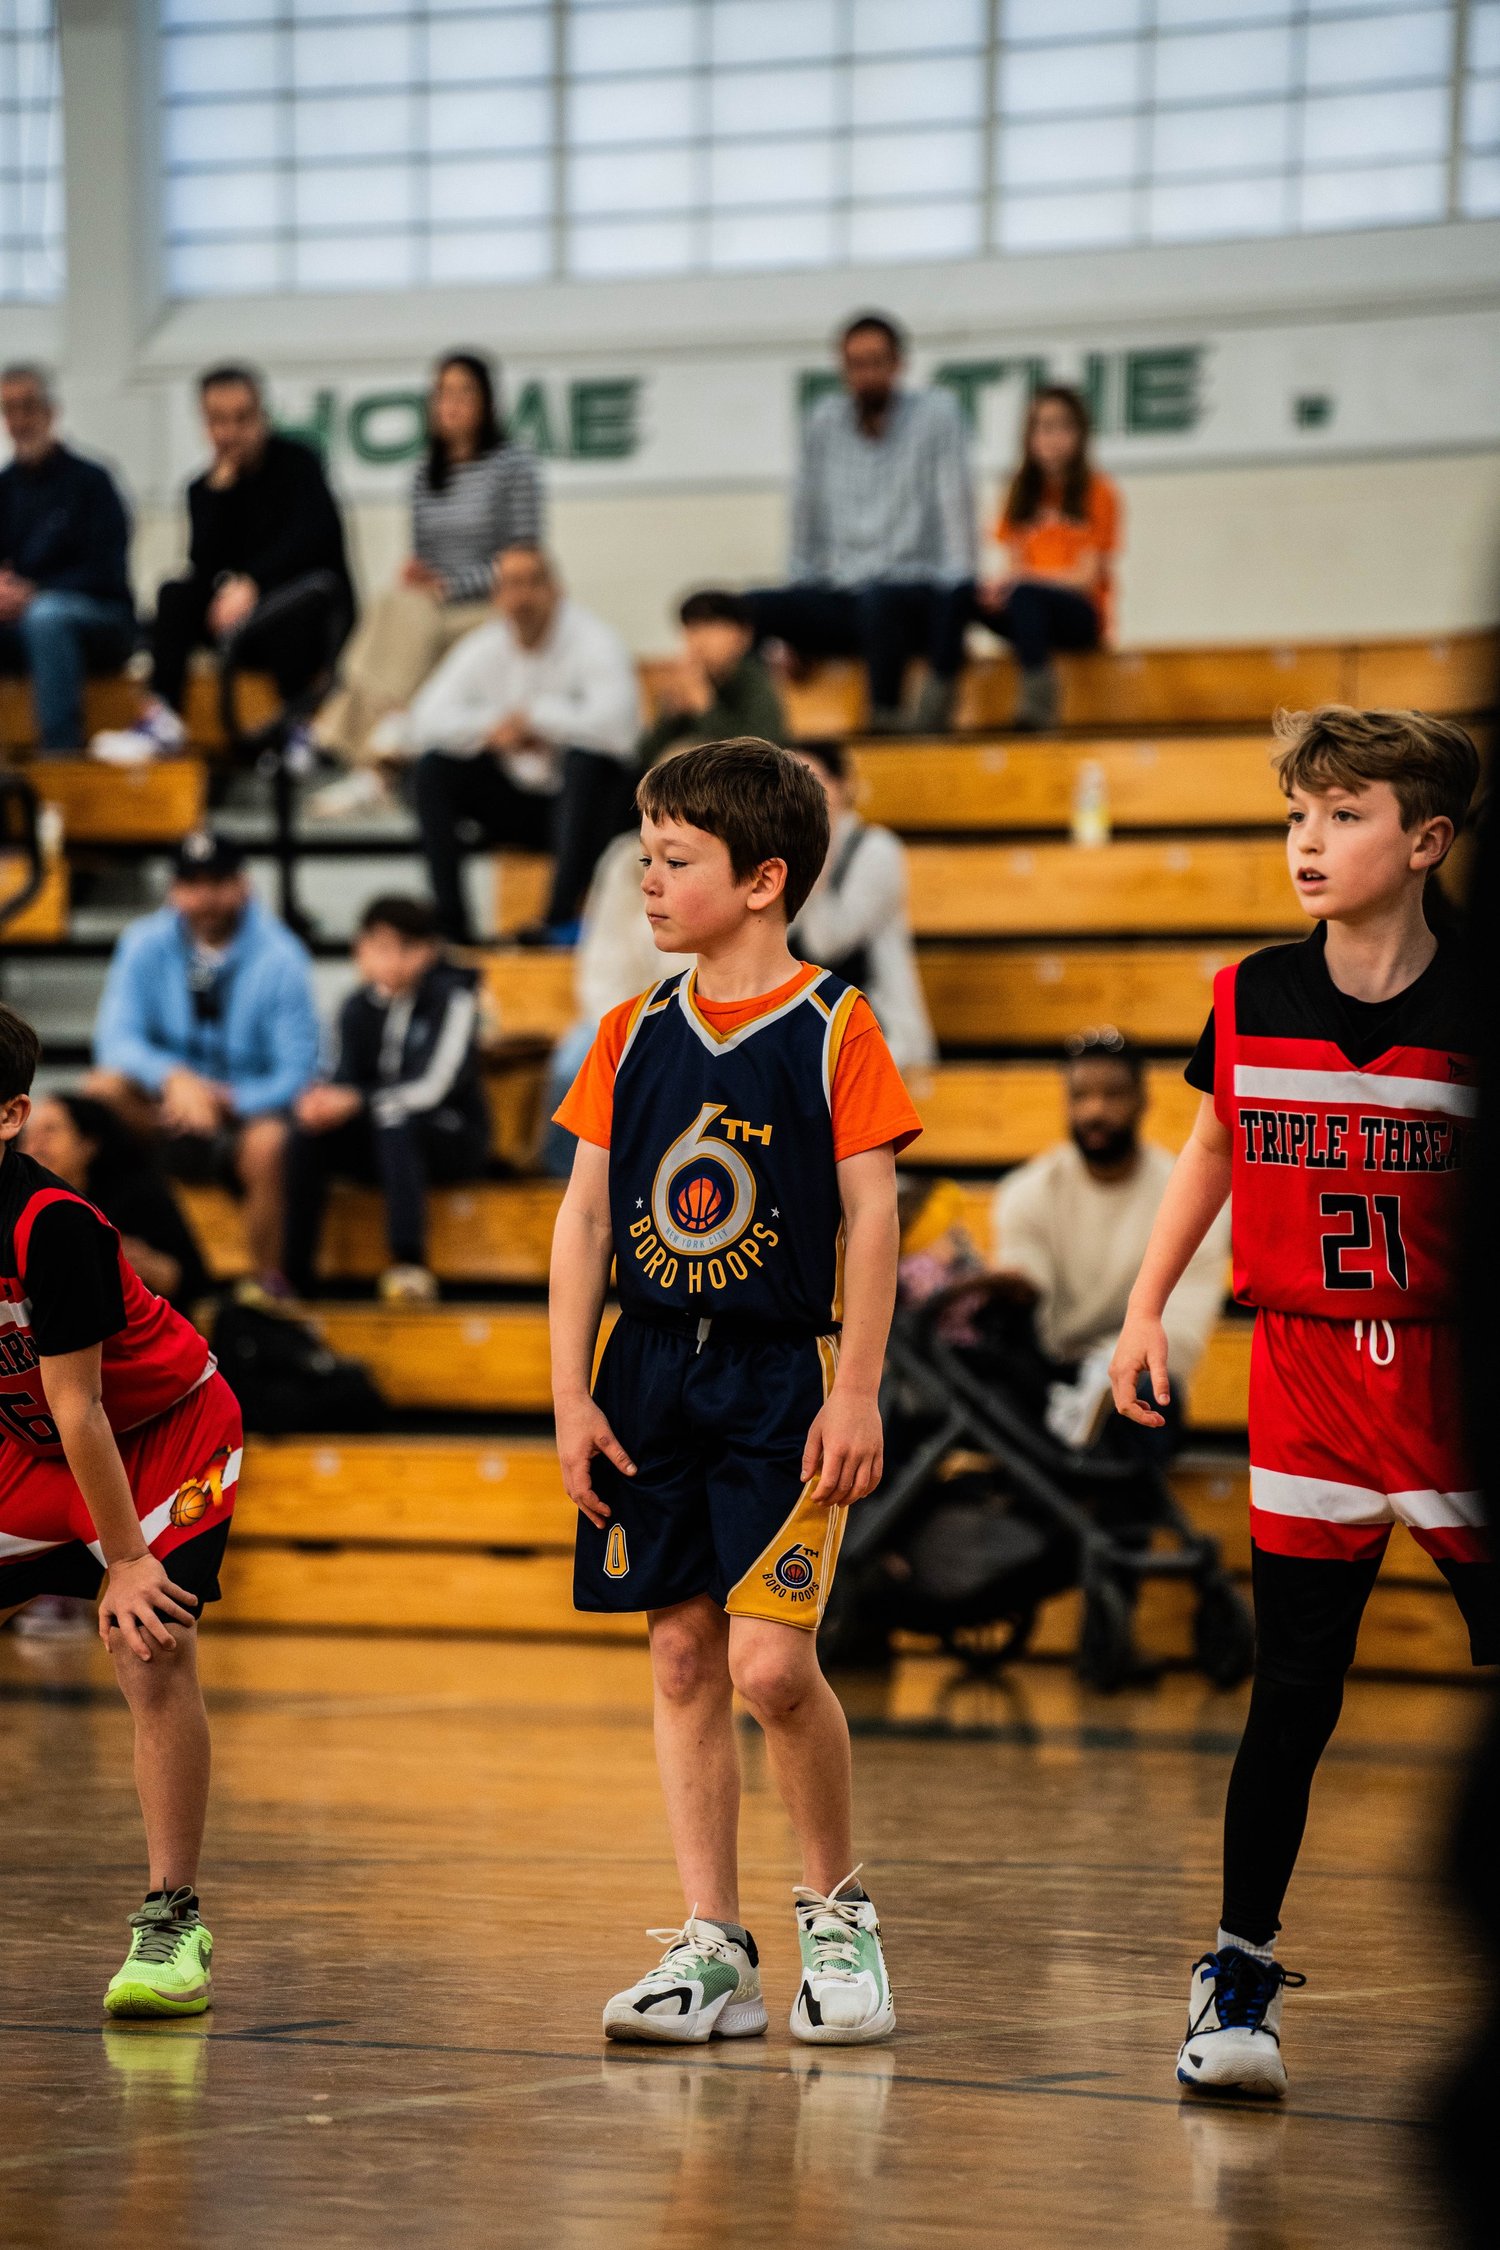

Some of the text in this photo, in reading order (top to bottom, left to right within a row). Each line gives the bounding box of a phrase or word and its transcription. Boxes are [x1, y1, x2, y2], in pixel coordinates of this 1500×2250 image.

[1238, 1108, 1349, 1171] TRIPLE
[629, 1215, 779, 1294] BORO HOOPS
[665, 1226, 729, 1249] NEW YORK CITY
[1319, 1192, 1409, 1291] 21
[762, 1573, 787, 1598] BORO
[791, 1582, 820, 1602] HOOPS
